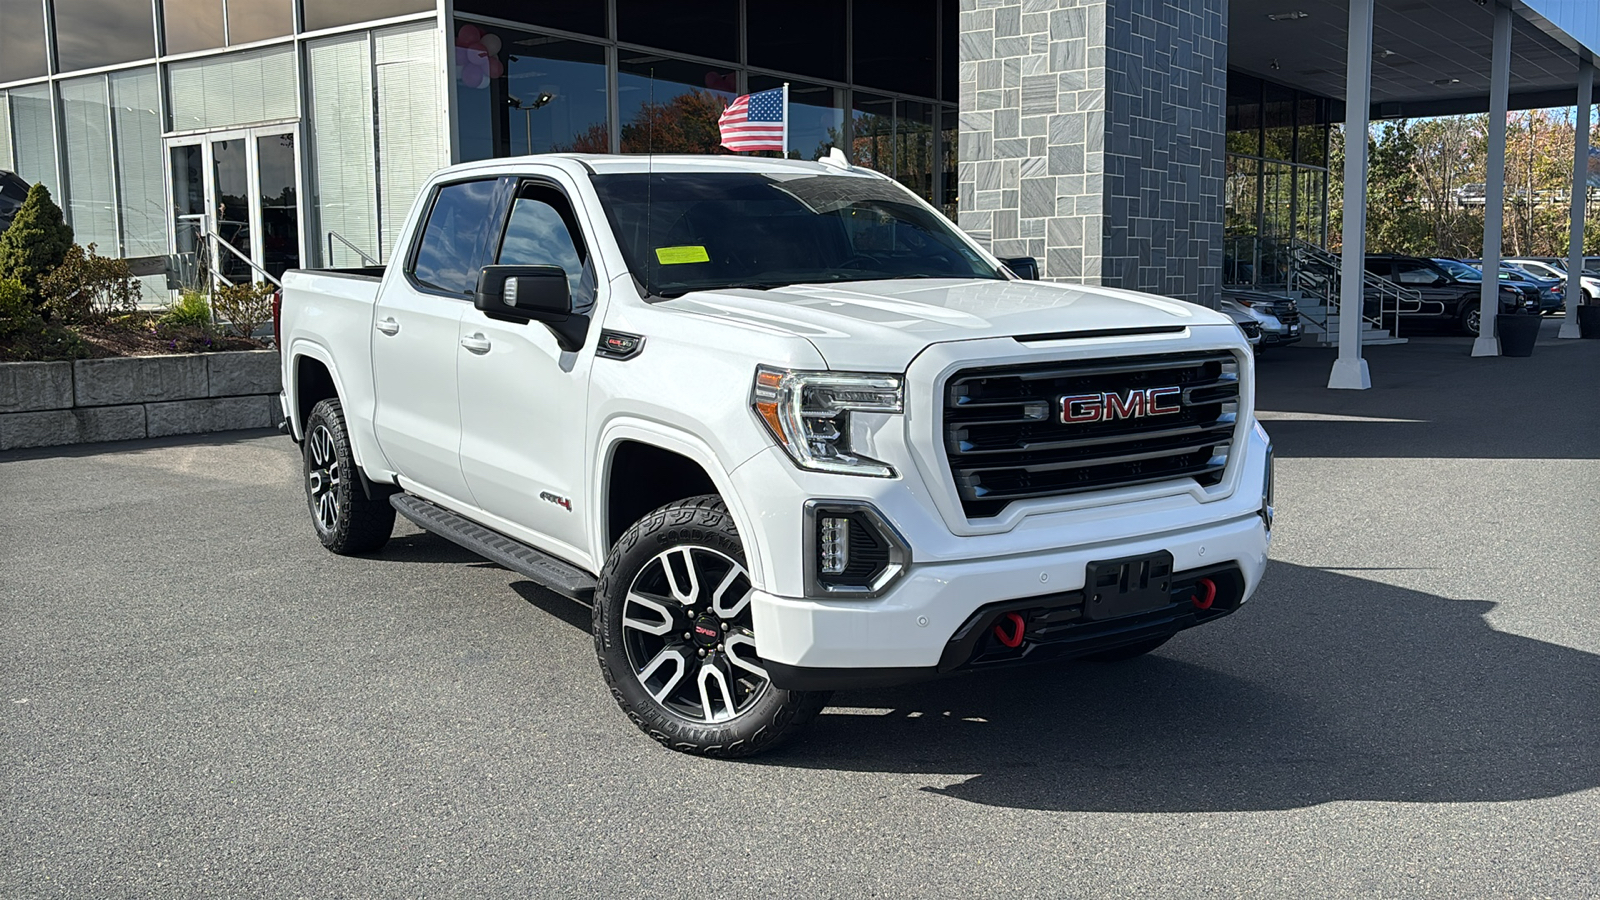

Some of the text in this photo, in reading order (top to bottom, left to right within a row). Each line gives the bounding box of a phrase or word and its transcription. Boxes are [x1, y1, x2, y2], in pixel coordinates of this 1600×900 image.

[1060, 386, 1180, 424] GMC
[540, 491, 572, 513] AT4
[656, 528, 745, 560] GOODYEA
[695, 626, 716, 637] GMC
[637, 699, 735, 743] WRANGLER
